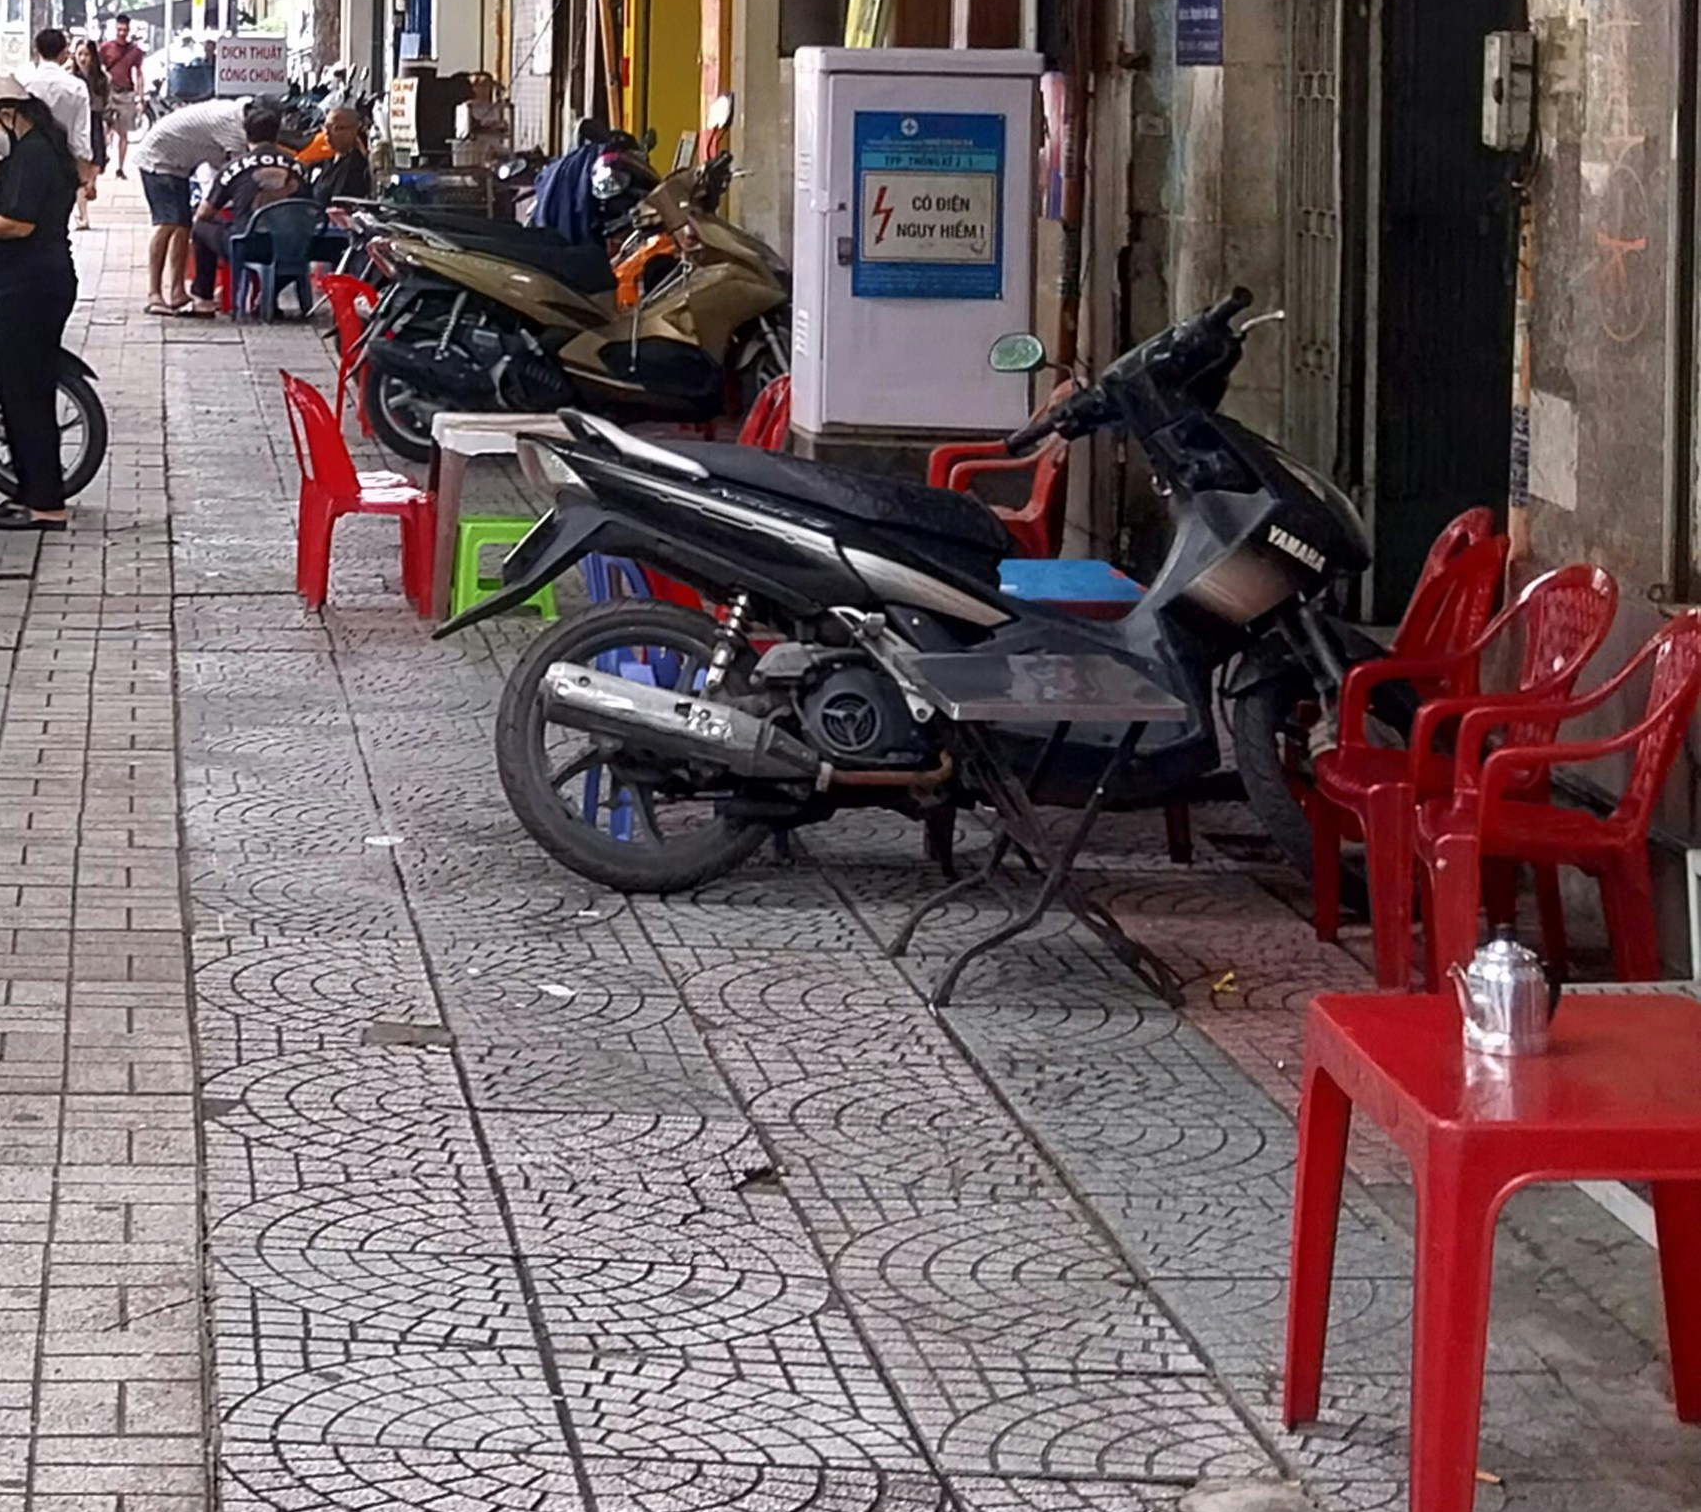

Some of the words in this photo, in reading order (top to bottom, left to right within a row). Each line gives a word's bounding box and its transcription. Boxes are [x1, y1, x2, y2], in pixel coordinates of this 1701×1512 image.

[221, 45, 247, 61] DỊCH
[249, 44, 283, 61] THUẬT
[219, 67, 248, 84] CÔNG
[911, 192, 933, 213] CÓ
[896, 223, 936, 239] NGUY
[1267, 524, 1326, 574] YAMAHA
